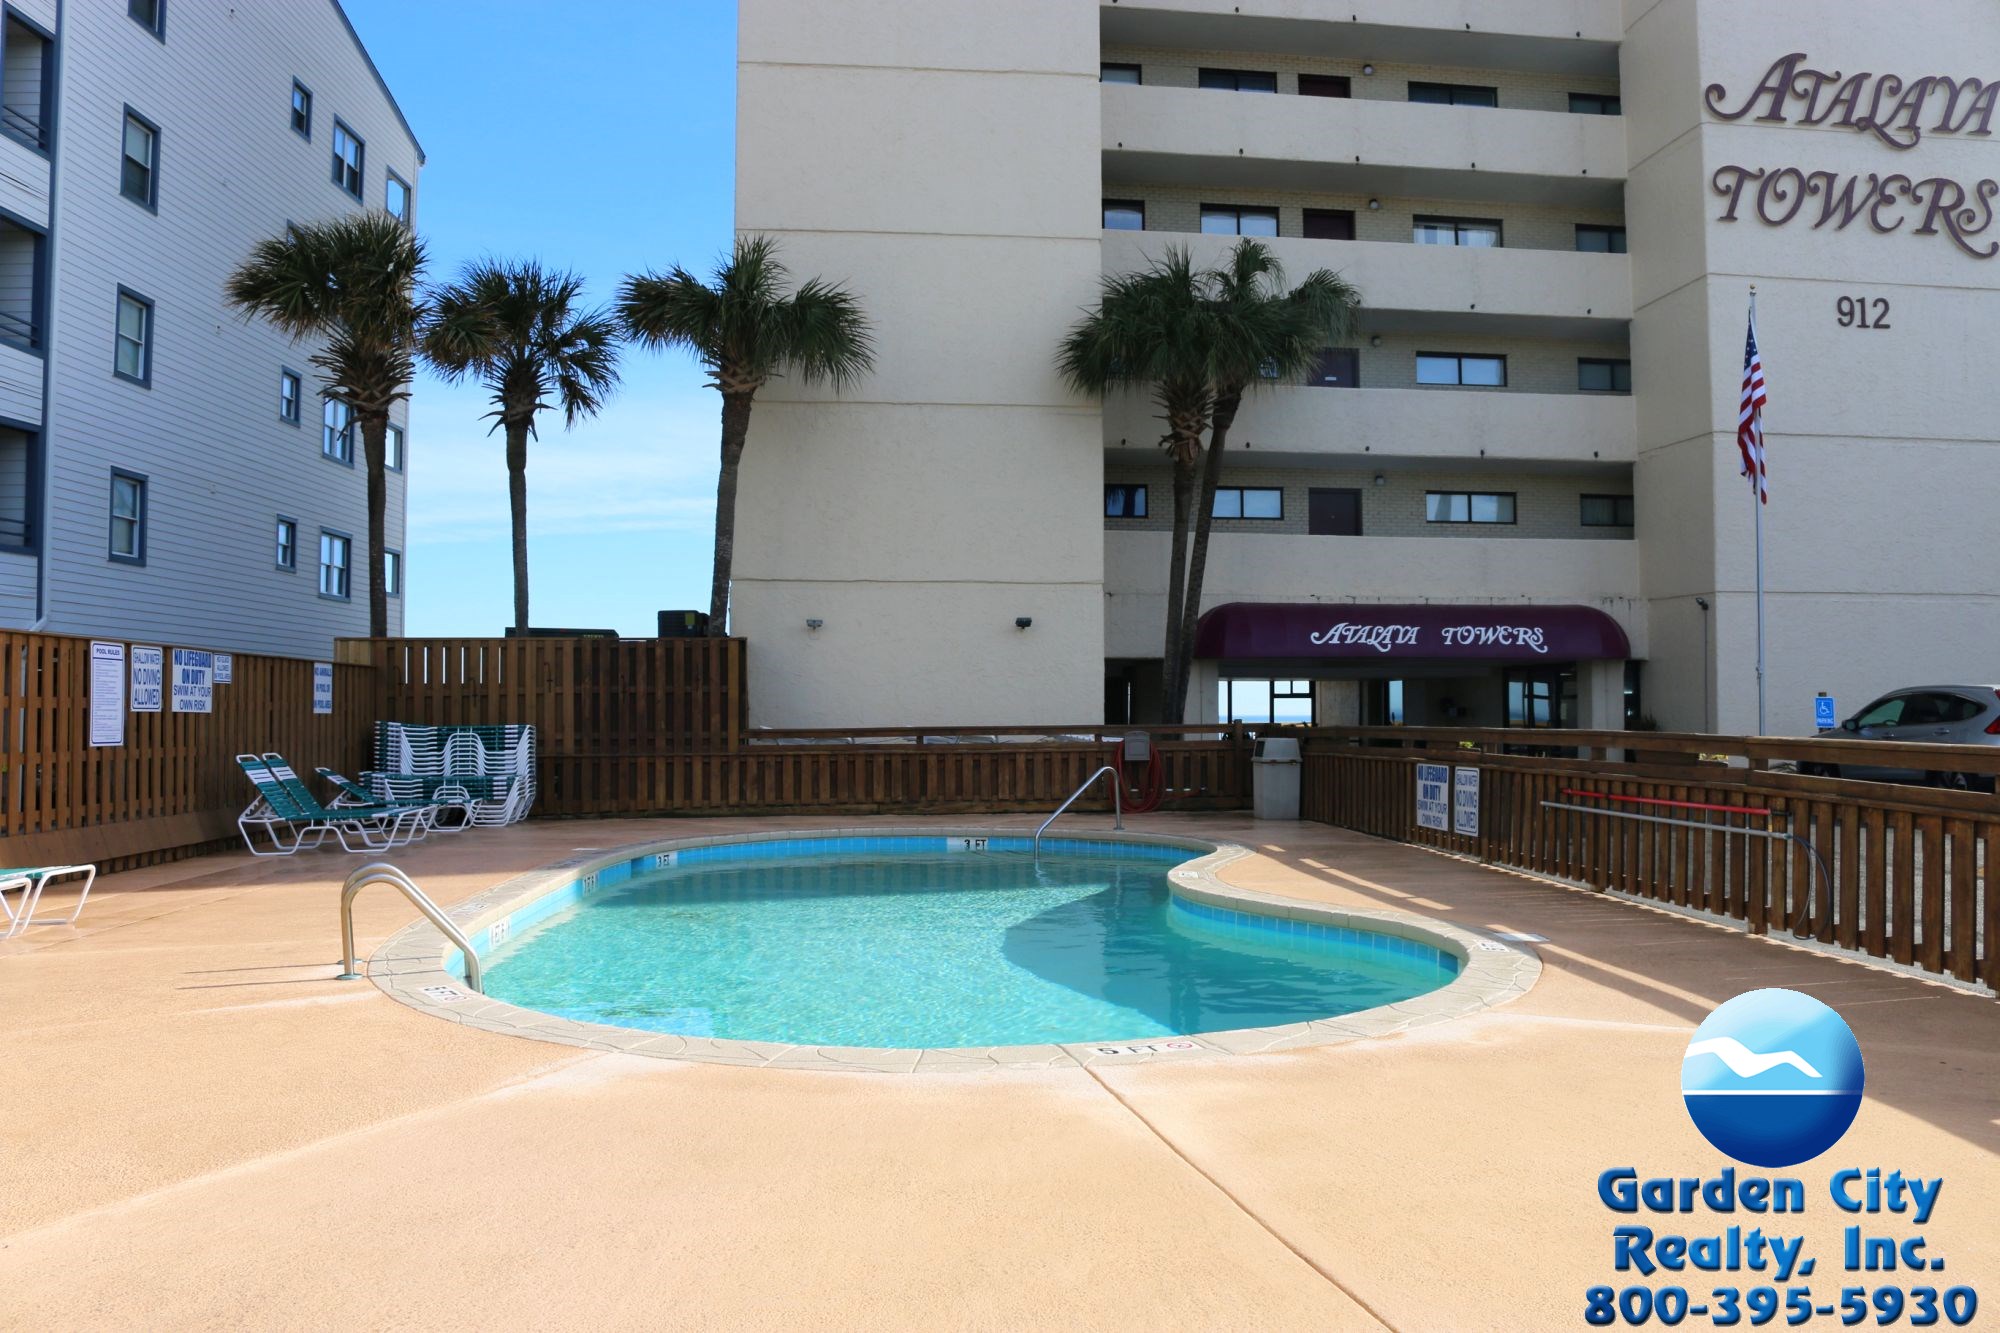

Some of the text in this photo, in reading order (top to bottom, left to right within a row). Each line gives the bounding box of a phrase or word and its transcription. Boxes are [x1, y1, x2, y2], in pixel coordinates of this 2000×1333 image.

[1705, 52, 2000, 150] ATALAYA
[1712, 164, 1999, 259] TOWERS
[1836, 295, 1891, 330] 912
[1310, 622, 1548, 653] ATALAYA TOWERS
[96, 647, 120, 656] POOL RULES
[174, 649, 211, 668] NO LIFEGUARD
[133, 667, 161, 686] NO DIVING
[182, 668, 206, 686] ON DUTY
[133, 688, 160, 706] ALLOWED
[173, 684, 212, 698] SWIM AT YOUR
[179, 699, 206, 711] OWN RISK
[1423, 783, 1441, 802] ON DUTY
[964, 839, 986, 850] 3 FT
[1098, 1047, 1119, 1055] 5
